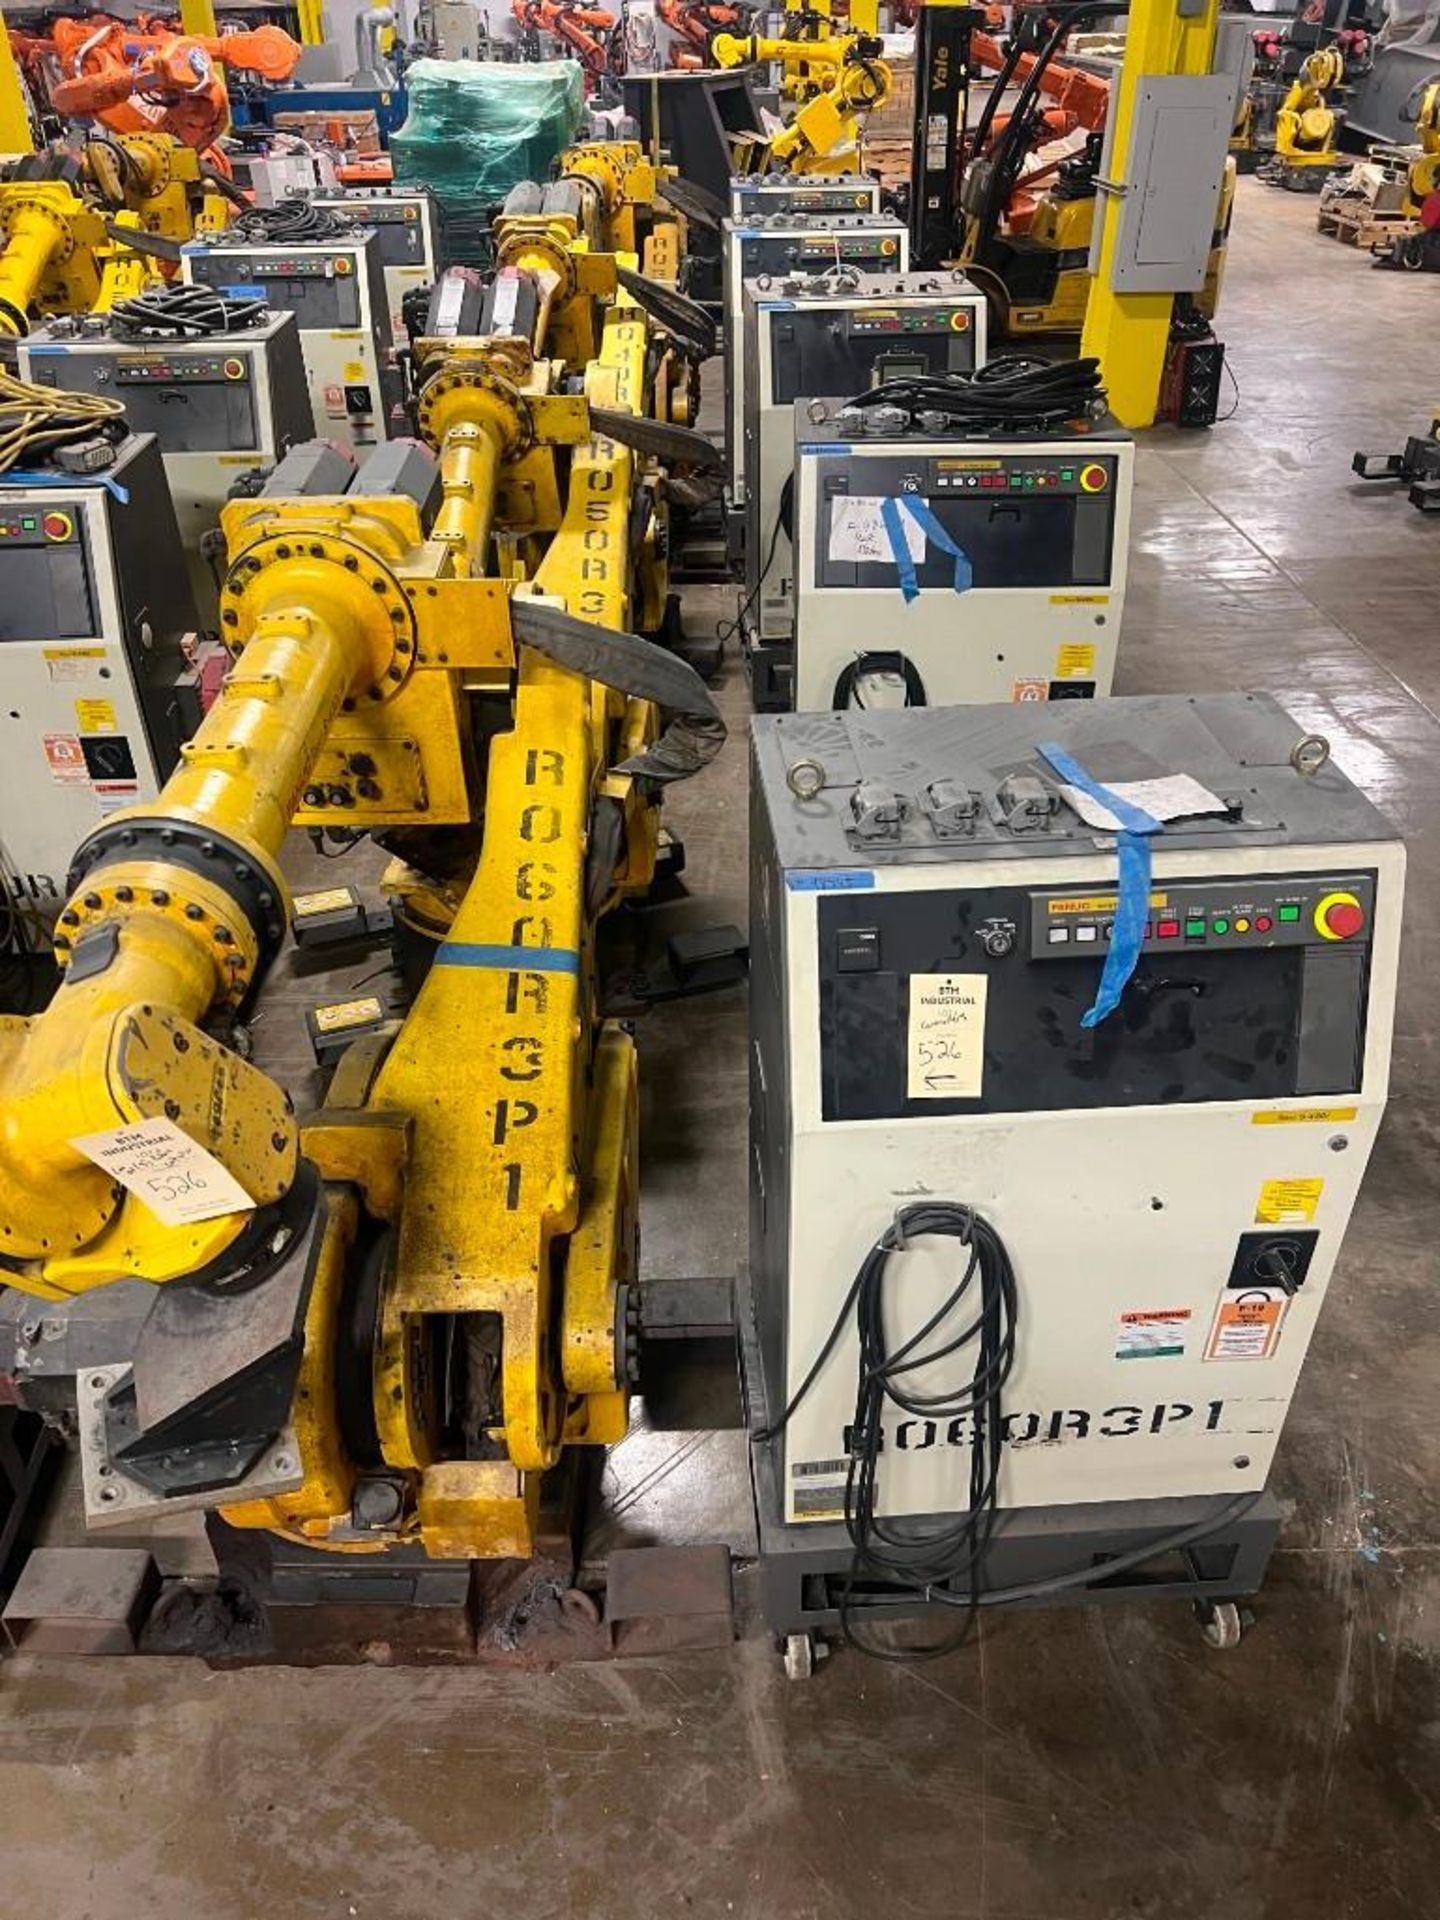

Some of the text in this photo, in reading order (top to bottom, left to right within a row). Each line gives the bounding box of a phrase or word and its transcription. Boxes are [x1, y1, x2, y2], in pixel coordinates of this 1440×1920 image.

[932, 46, 950, 91] Yale
[920, 996, 976, 1006] INDUSTRIAL
[918, 1040, 962, 1067] 526
[146, 1171, 207, 1202] 526
